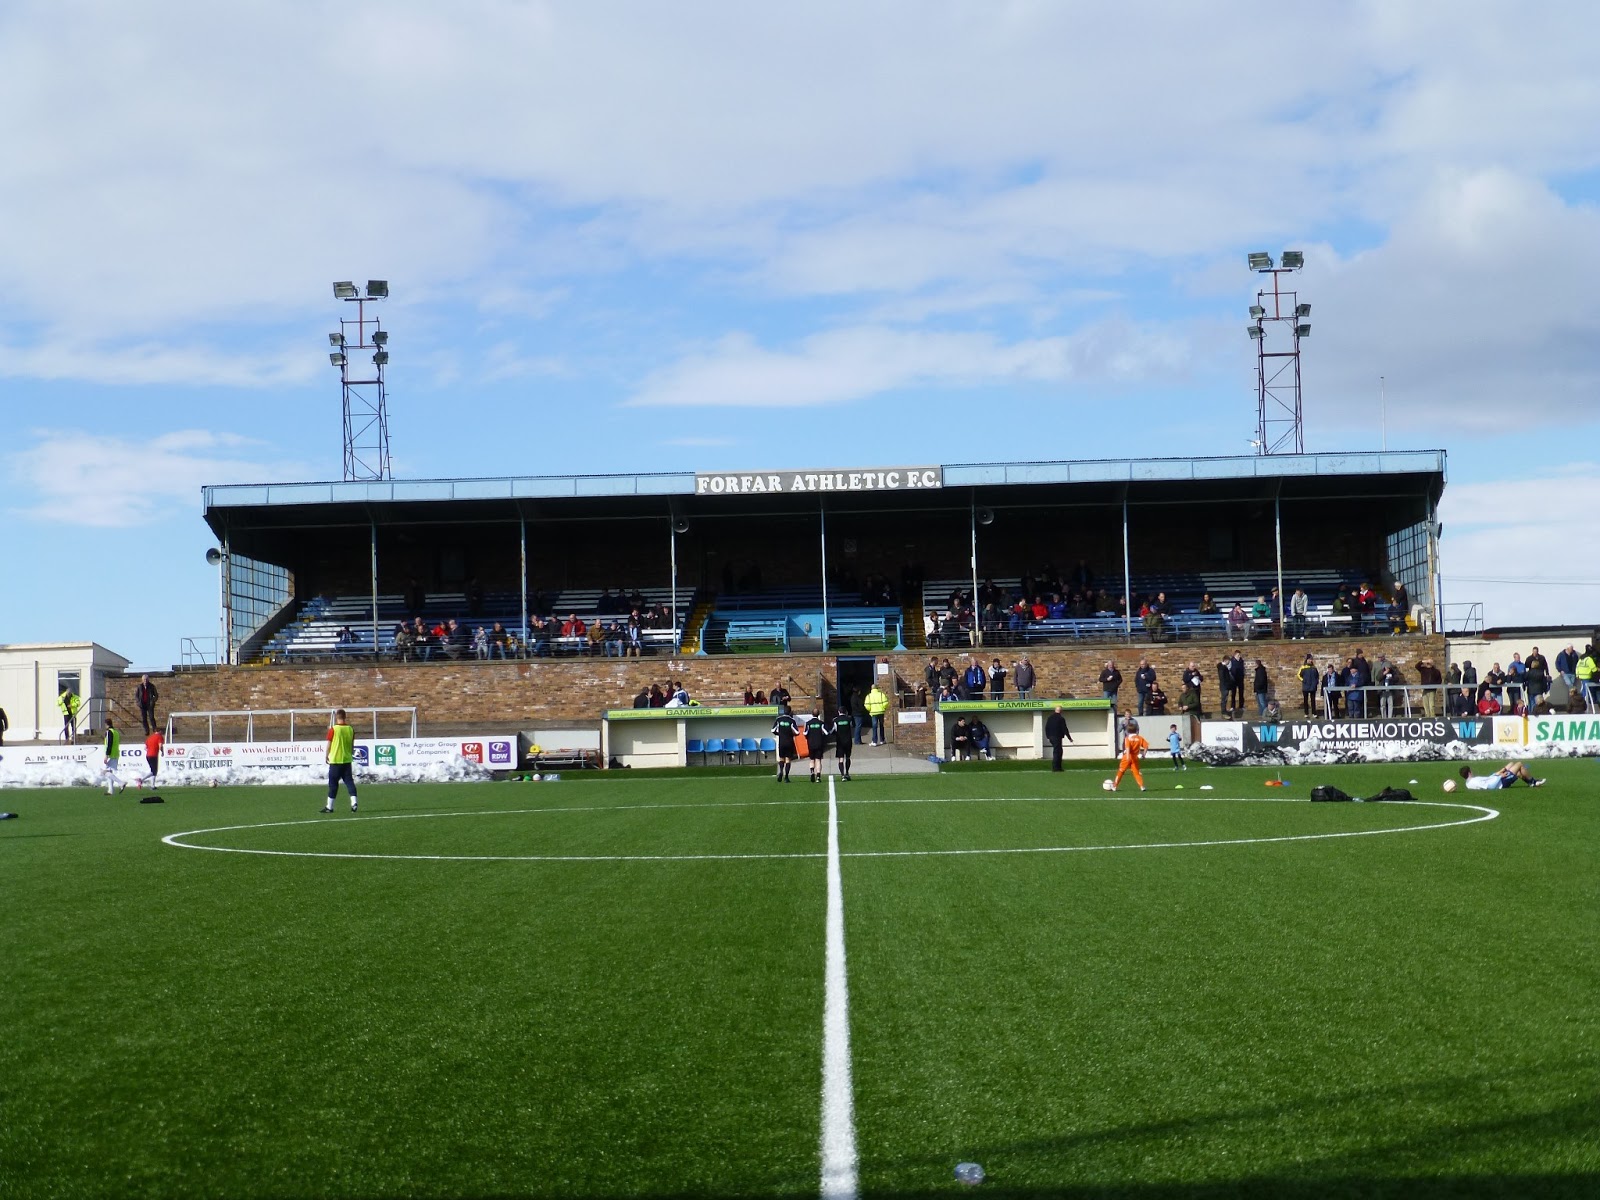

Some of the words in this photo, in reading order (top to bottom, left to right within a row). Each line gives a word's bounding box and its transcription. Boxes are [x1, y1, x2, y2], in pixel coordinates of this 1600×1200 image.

[697, 475, 783, 493] FORFAR
[790, 472, 900, 491] ATHLETIC
[907, 471, 940, 487] F.C.
[1291, 722, 1446, 740] MACKIEMOTORS
[1535, 721, 1600, 741] SAMA
[120, 749, 142, 757] ECO
[242, 745, 324, 754] www.lesturriff.co.uk
